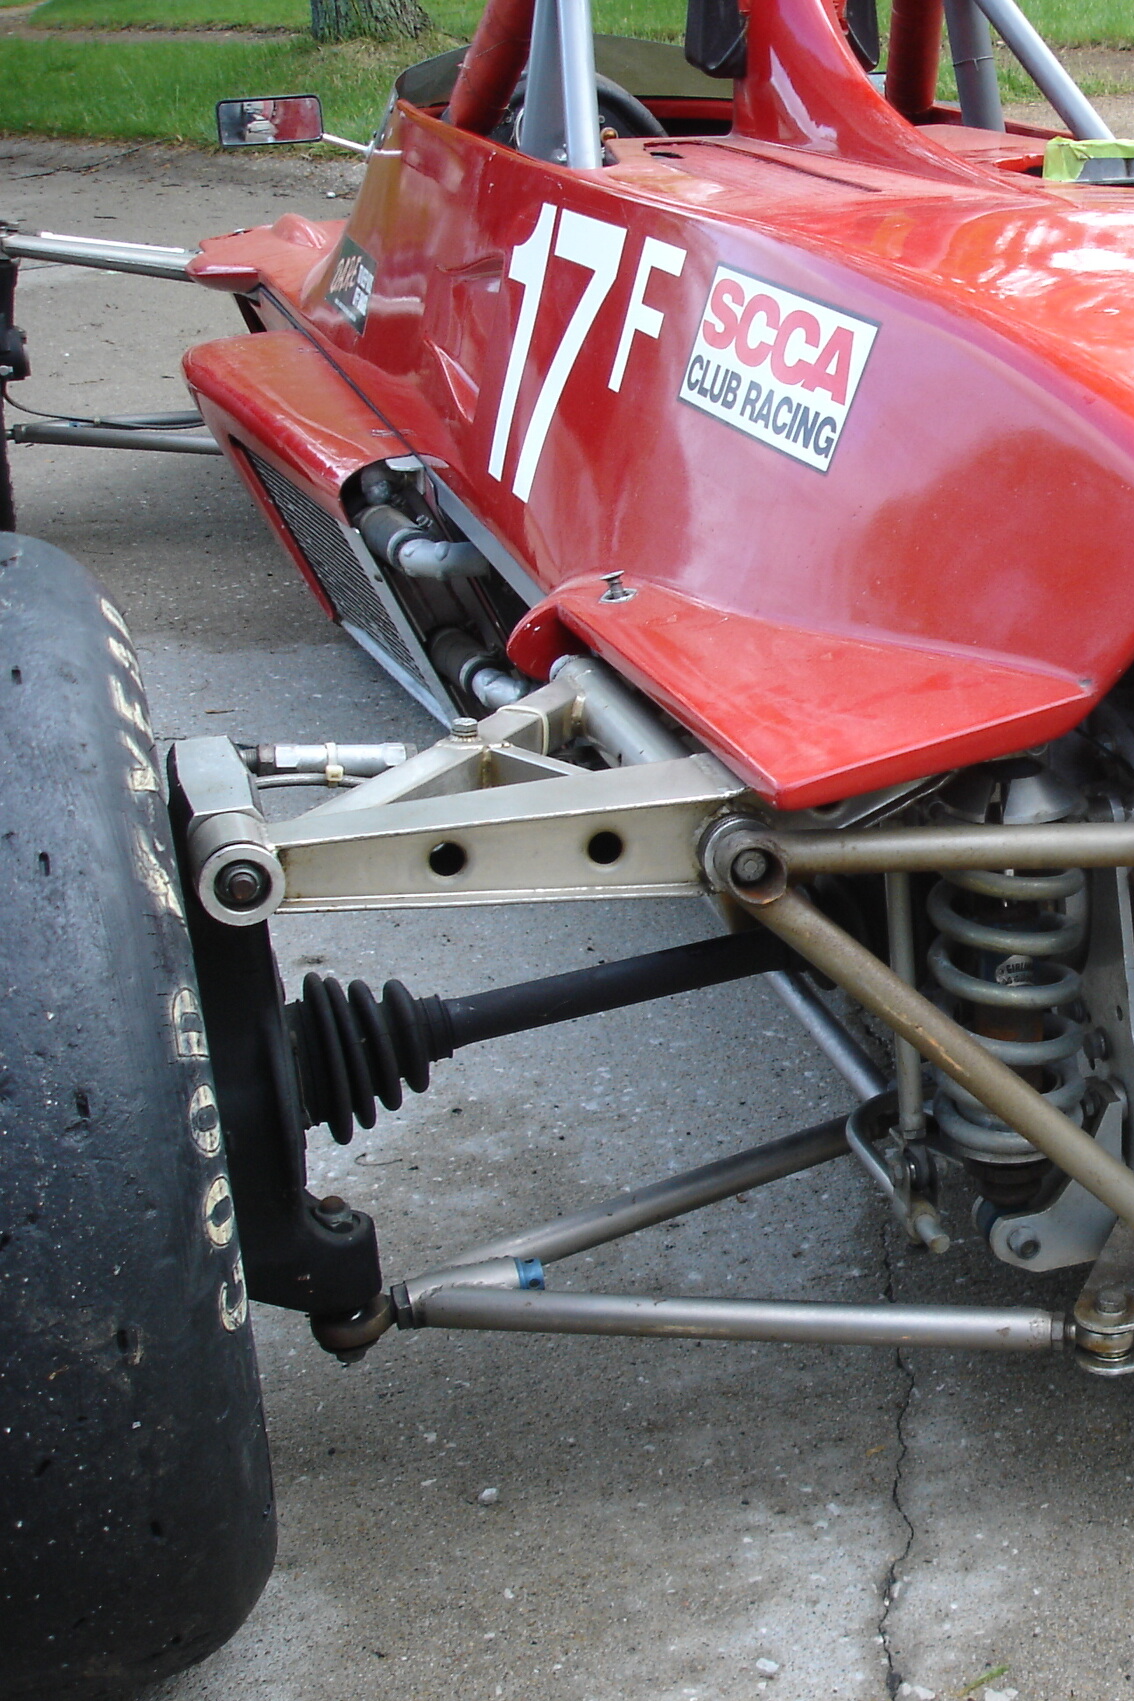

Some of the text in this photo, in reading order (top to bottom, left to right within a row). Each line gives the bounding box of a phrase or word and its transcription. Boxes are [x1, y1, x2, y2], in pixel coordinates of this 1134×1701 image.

[488, 203, 687, 503] 17 F
[702, 278, 854, 406] SCCA
[687, 354, 837, 459] CLUB RACING
